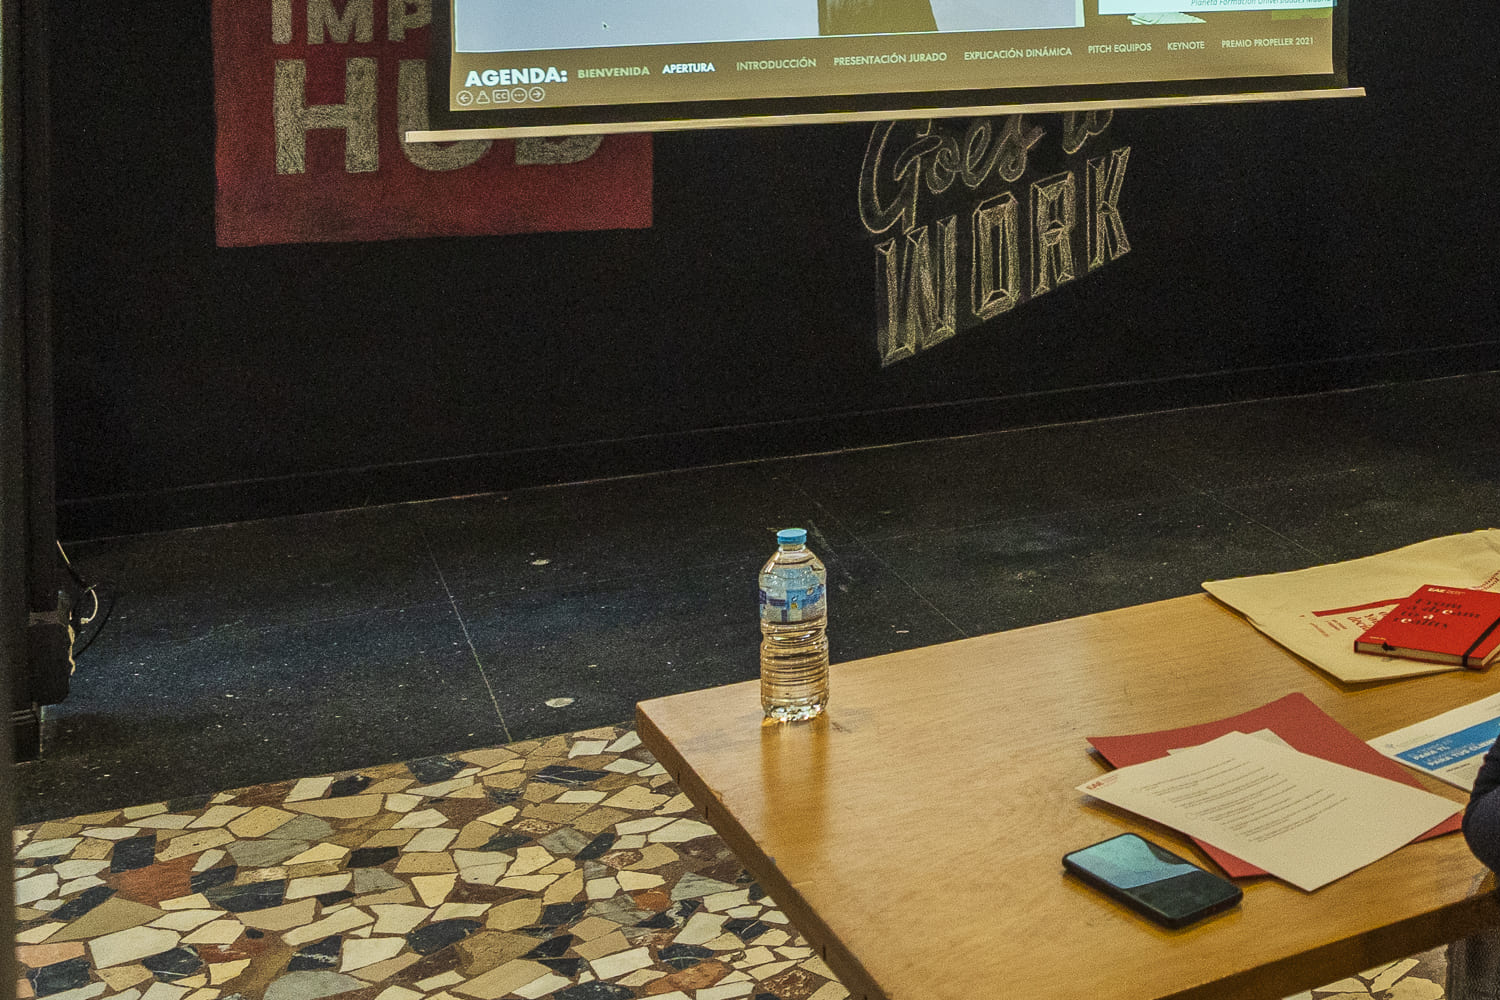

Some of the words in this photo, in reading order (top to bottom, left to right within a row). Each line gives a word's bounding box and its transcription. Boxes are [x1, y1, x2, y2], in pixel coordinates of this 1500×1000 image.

[465, 67, 568, 88] AGENDA:
[577, 66, 650, 79] BIENVENIDA
[662, 62, 715, 74] APERTURA
[736, 57, 817, 71] INTRODUCCIÓN
[833, 53, 905, 66] PRESENTACIÓN
[909, 52, 947, 64] JURADO
[964, 47, 1023, 61] EXPLICACIÓN
[1025, 46, 1073, 59] DINÁMICA
[1088, 45, 1112, 55] PITCH
[1113, 42, 1152, 53] EQUIPOS
[1167, 41, 1205, 51] KEYNOTE
[1221, 39, 1252, 49] PREMIO
[1254, 38, 1294, 48] PROPELLER
[1295, 37, 1314, 46] 2021
[874, 146, 1132, 368] WORK
